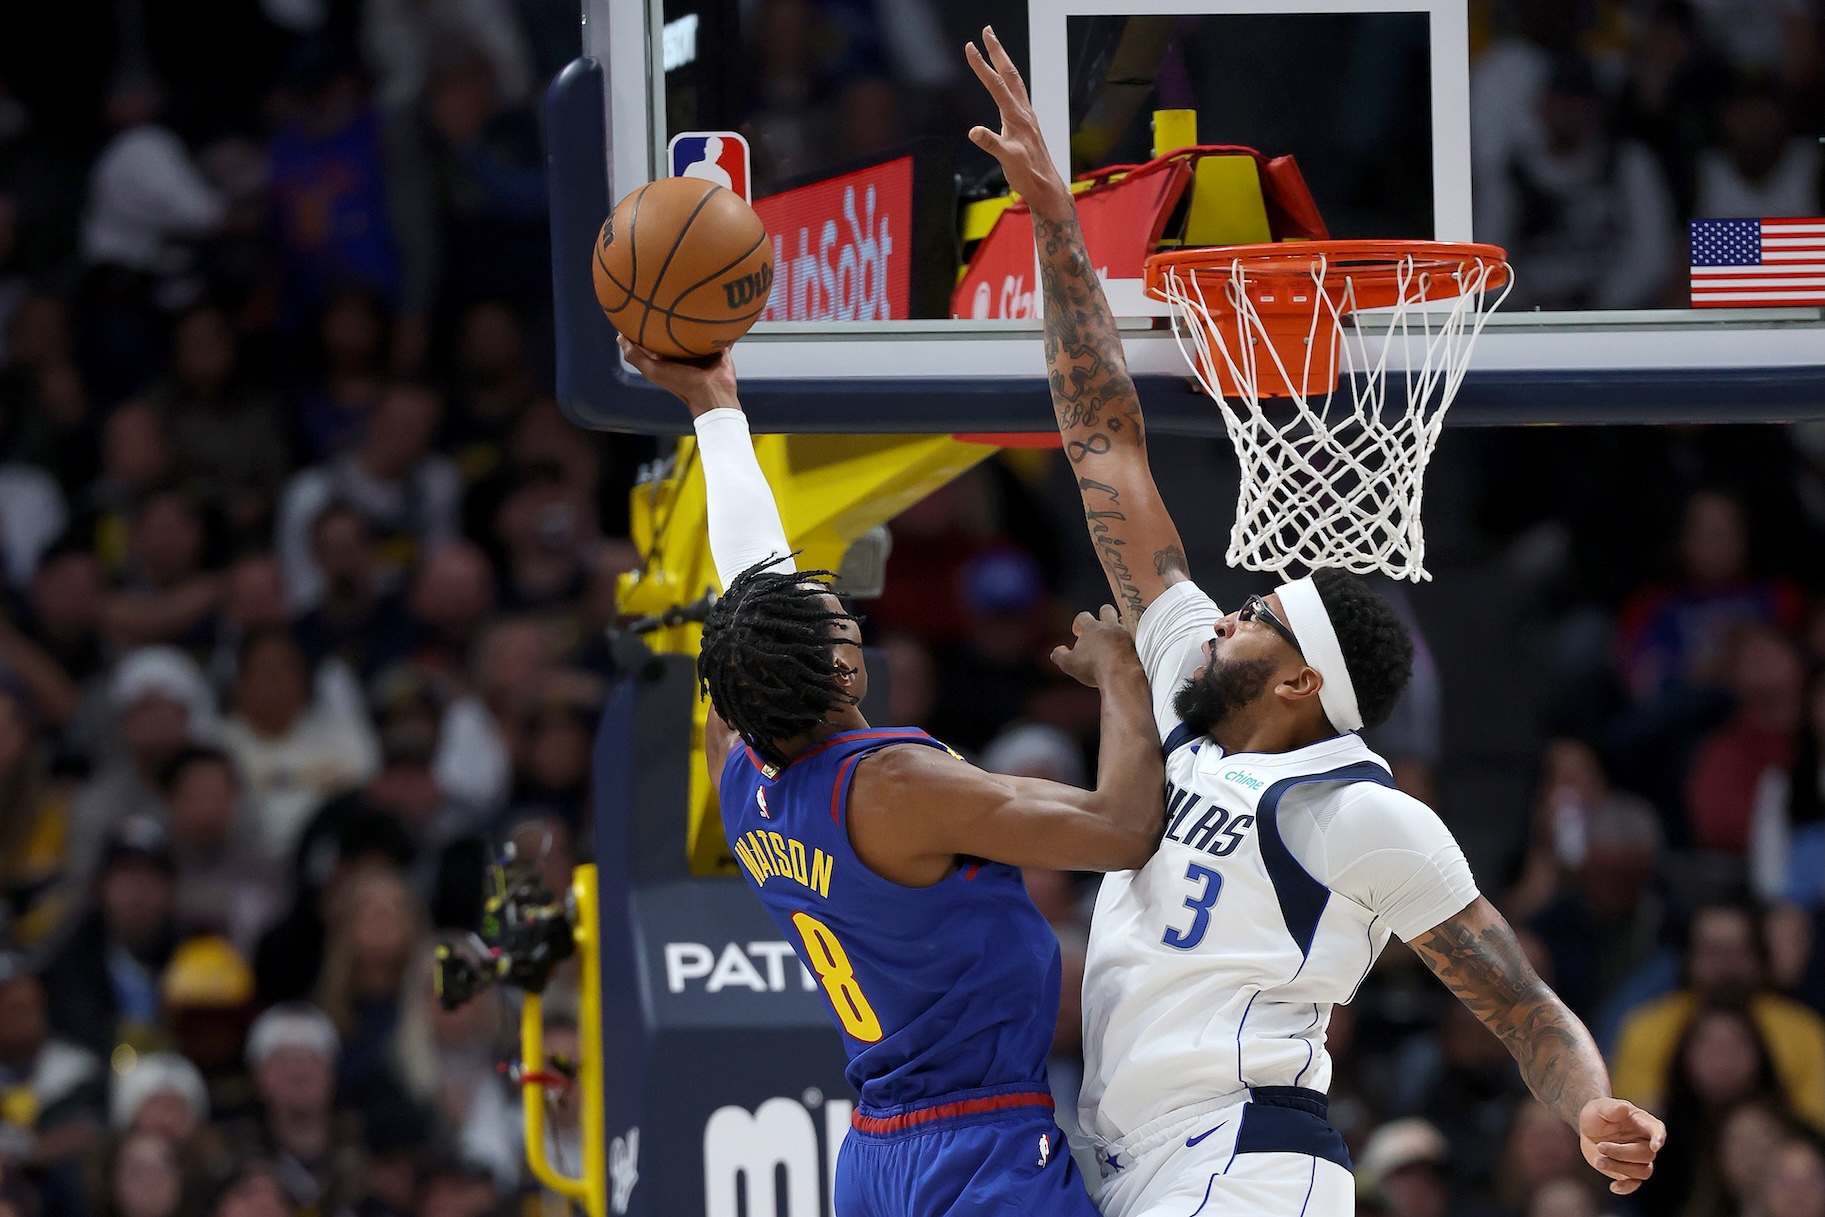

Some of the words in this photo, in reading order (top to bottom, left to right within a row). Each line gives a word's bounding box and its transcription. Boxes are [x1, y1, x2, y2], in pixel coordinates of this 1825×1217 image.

[1225, 770, 1264, 790] chime
[734, 830, 834, 899] WATSON
[1161, 861, 1225, 951] 3
[790, 910, 883, 1044] 8
